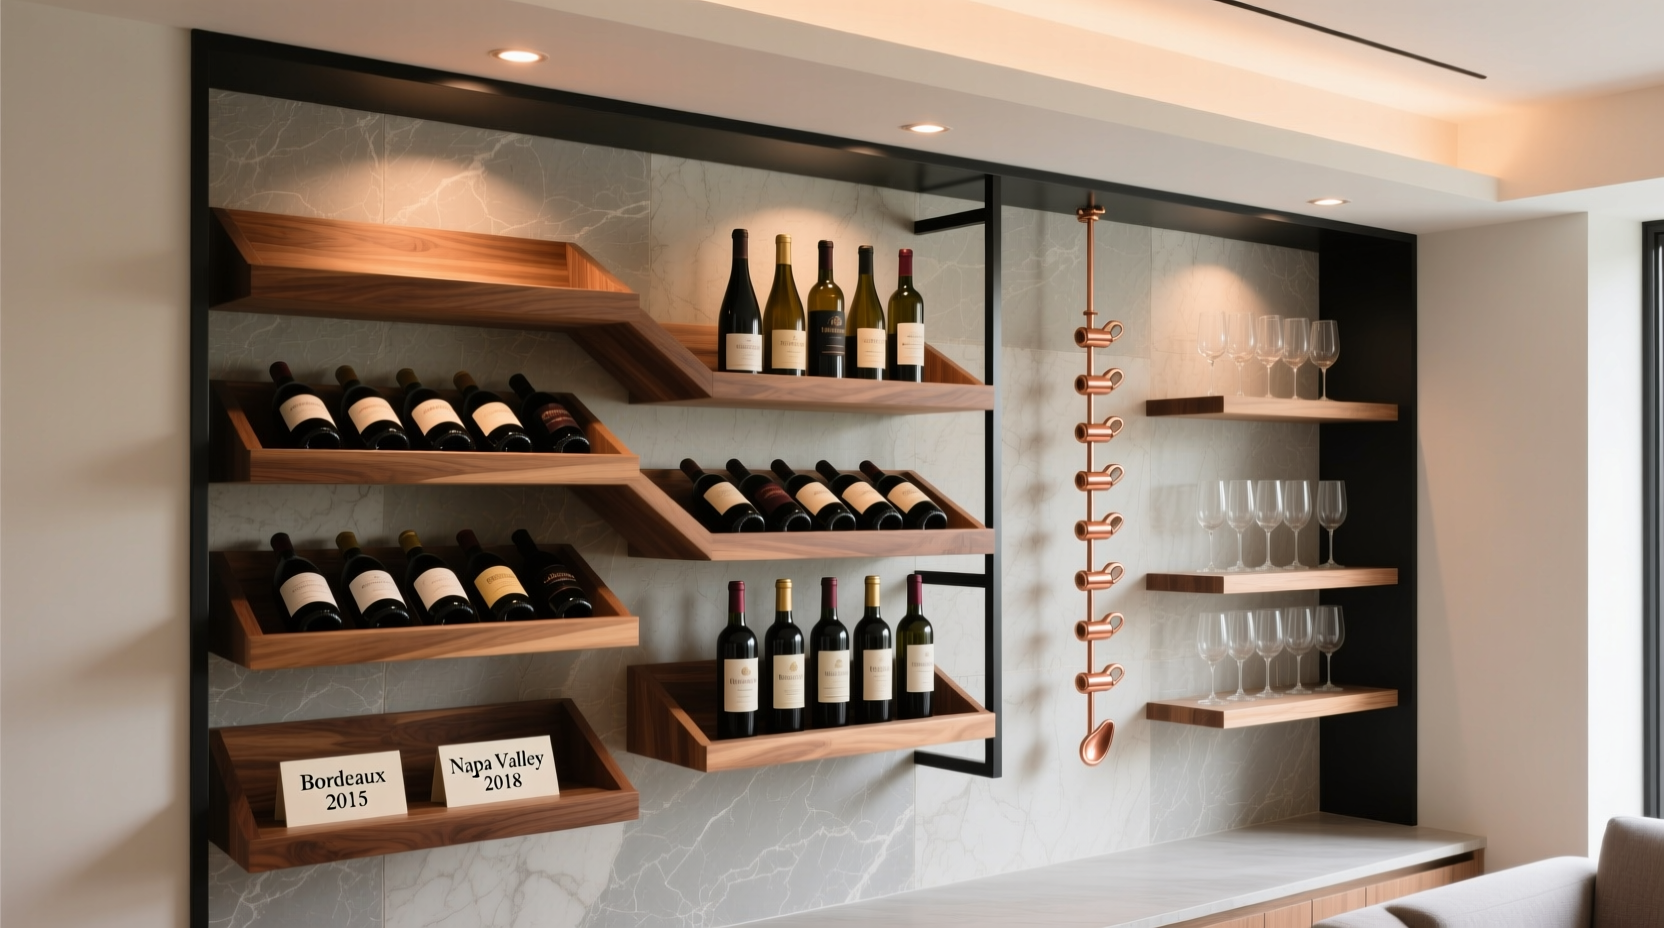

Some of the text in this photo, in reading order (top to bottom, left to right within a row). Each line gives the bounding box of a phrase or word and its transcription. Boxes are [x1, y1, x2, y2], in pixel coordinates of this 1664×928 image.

[449, 750, 544, 778] Napa Valley
[300, 770, 386, 791] Bordeaux
[484, 773, 522, 791] 2018
[325, 791, 368, 810] 2015
